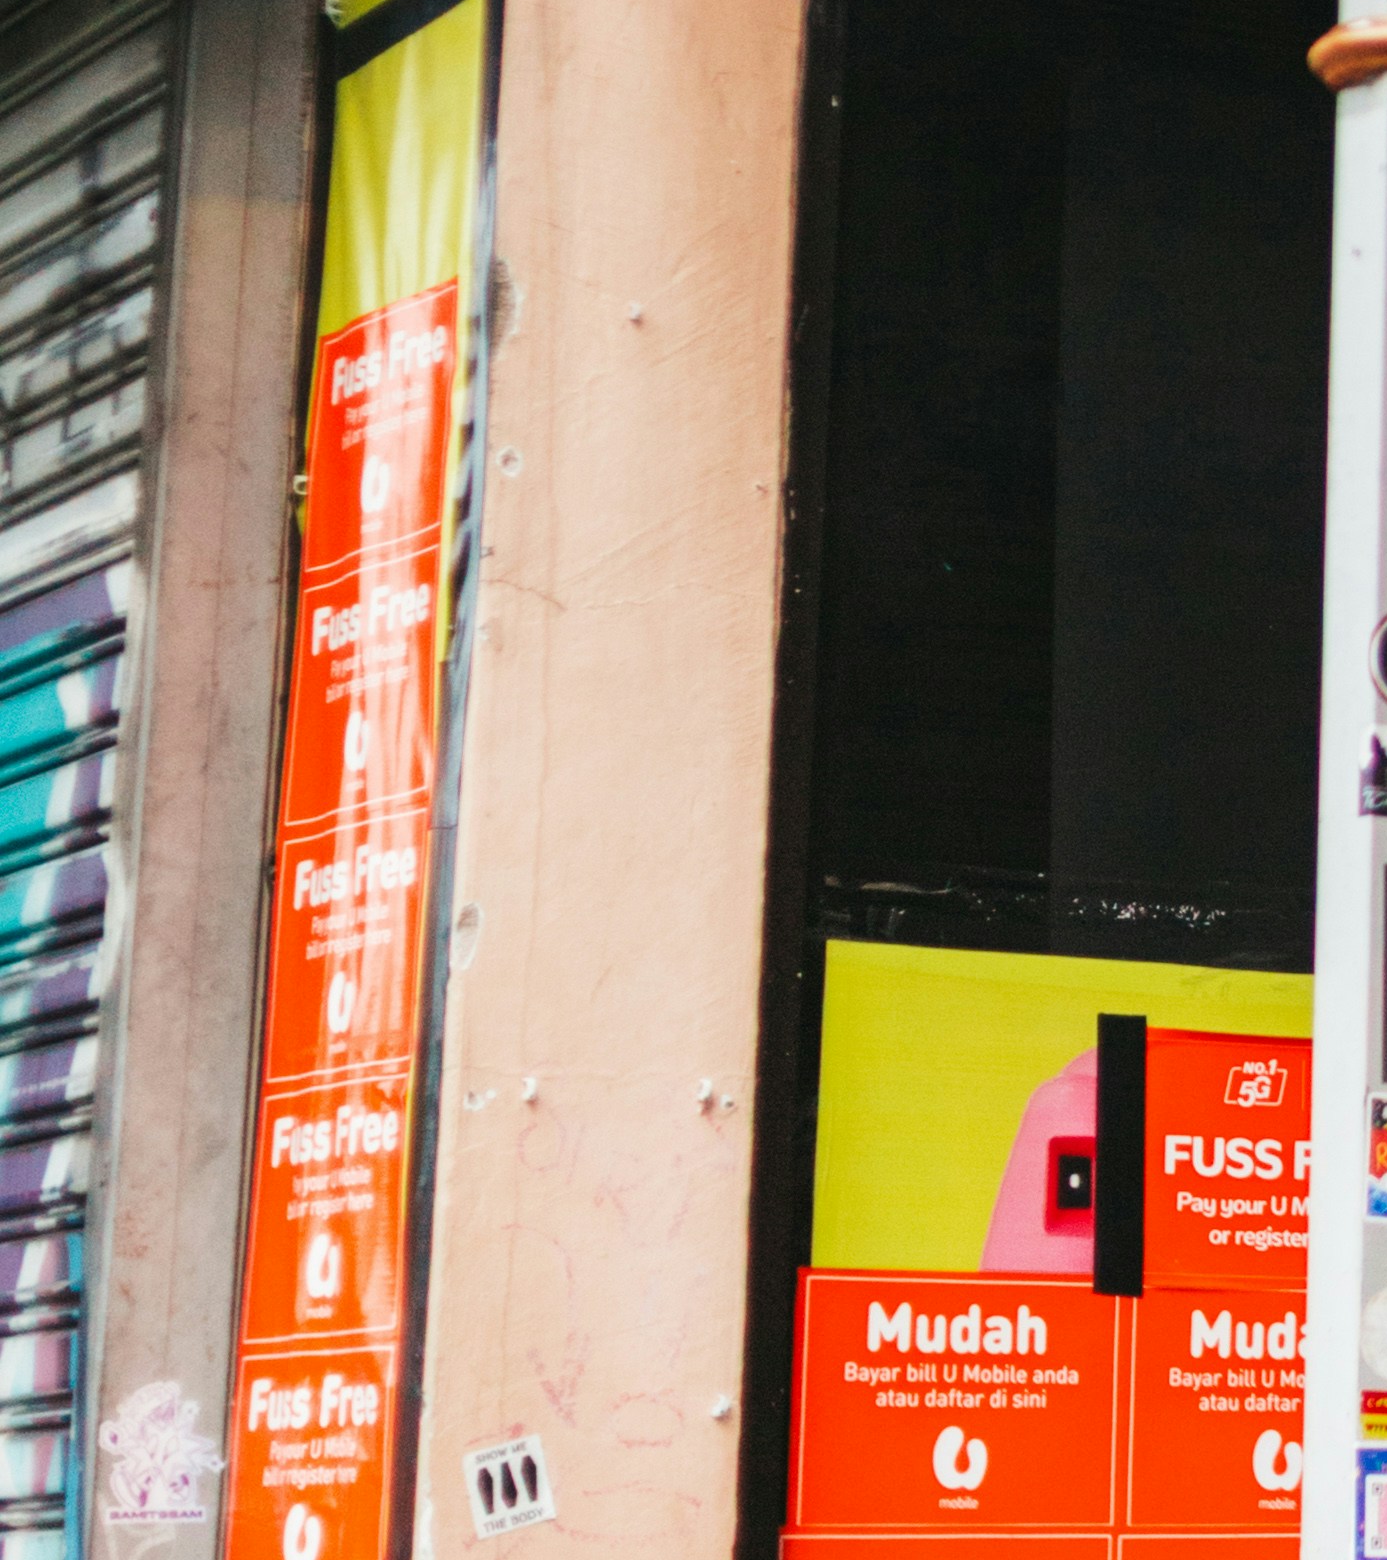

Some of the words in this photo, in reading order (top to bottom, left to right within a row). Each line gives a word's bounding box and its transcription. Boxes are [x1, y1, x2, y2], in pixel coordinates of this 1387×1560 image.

[368, 583, 430, 635] Free
[355, 843, 417, 896] Free
[335, 1105, 398, 1159] Free
[1163, 1134, 1283, 1179] FUSS
[1176, 1191, 1217, 1218] Pay
[1220, 1194, 1268, 1219] your
[1270, 1196, 1288, 1217] U
[1209, 1230, 1232, 1247] or
[867, 1301, 1047, 1355] Mudah
[1189, 1309, 1310, 1360] Mud
[844, 1361, 900, 1387] Bayar
[907, 1363, 937, 1382] bill
[943, 1364, 957, 1383] U
[963, 1364, 1027, 1384] Mobile
[1032, 1367, 1079, 1385] anda
[1168, 1367, 1223, 1392] Bayar
[1226, 1367, 1256, 1388] bill
[1260, 1369, 1276, 1388] U
[319, 1373, 378, 1428] Free
[876, 1390, 919, 1407] atau
[924, 1388, 984, 1408] daftar
[989, 1389, 1007, 1408] di
[1012, 1389, 1047, 1408] sini
[1198, 1393, 1239, 1413] atau
[1243, 1391, 1301, 1414] daftar
[475, 1447, 507, 1465] SHOW
[511, 1441, 527, 1455] ME
[484, 1517, 507, 1533] THE
[510, 1506, 544, 1527] BODY
